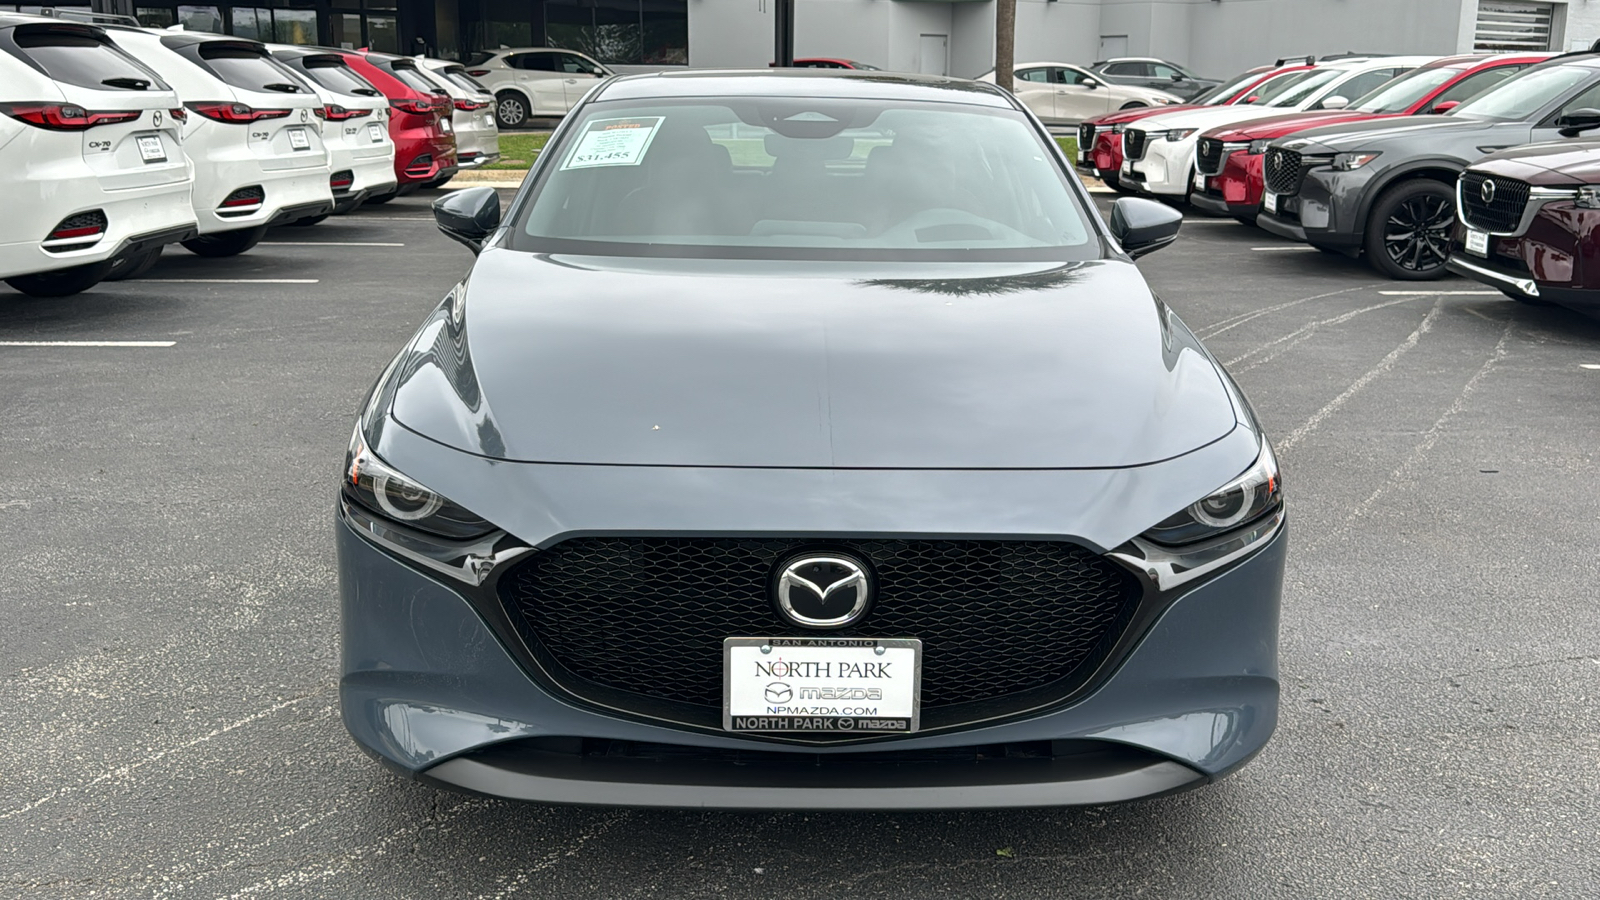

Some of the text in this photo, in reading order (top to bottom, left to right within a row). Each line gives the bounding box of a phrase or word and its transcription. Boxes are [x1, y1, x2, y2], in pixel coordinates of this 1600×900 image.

[88, 140, 111, 148] CX-70
[772, 639, 874, 647] SAN ANTONIO
[754, 660, 893, 678] NORTH PARK
[799, 686, 883, 701] mazda
[766, 706, 878, 715] NPMAZDA.COM
[735, 717, 907, 730] NORTH PARK mazda
